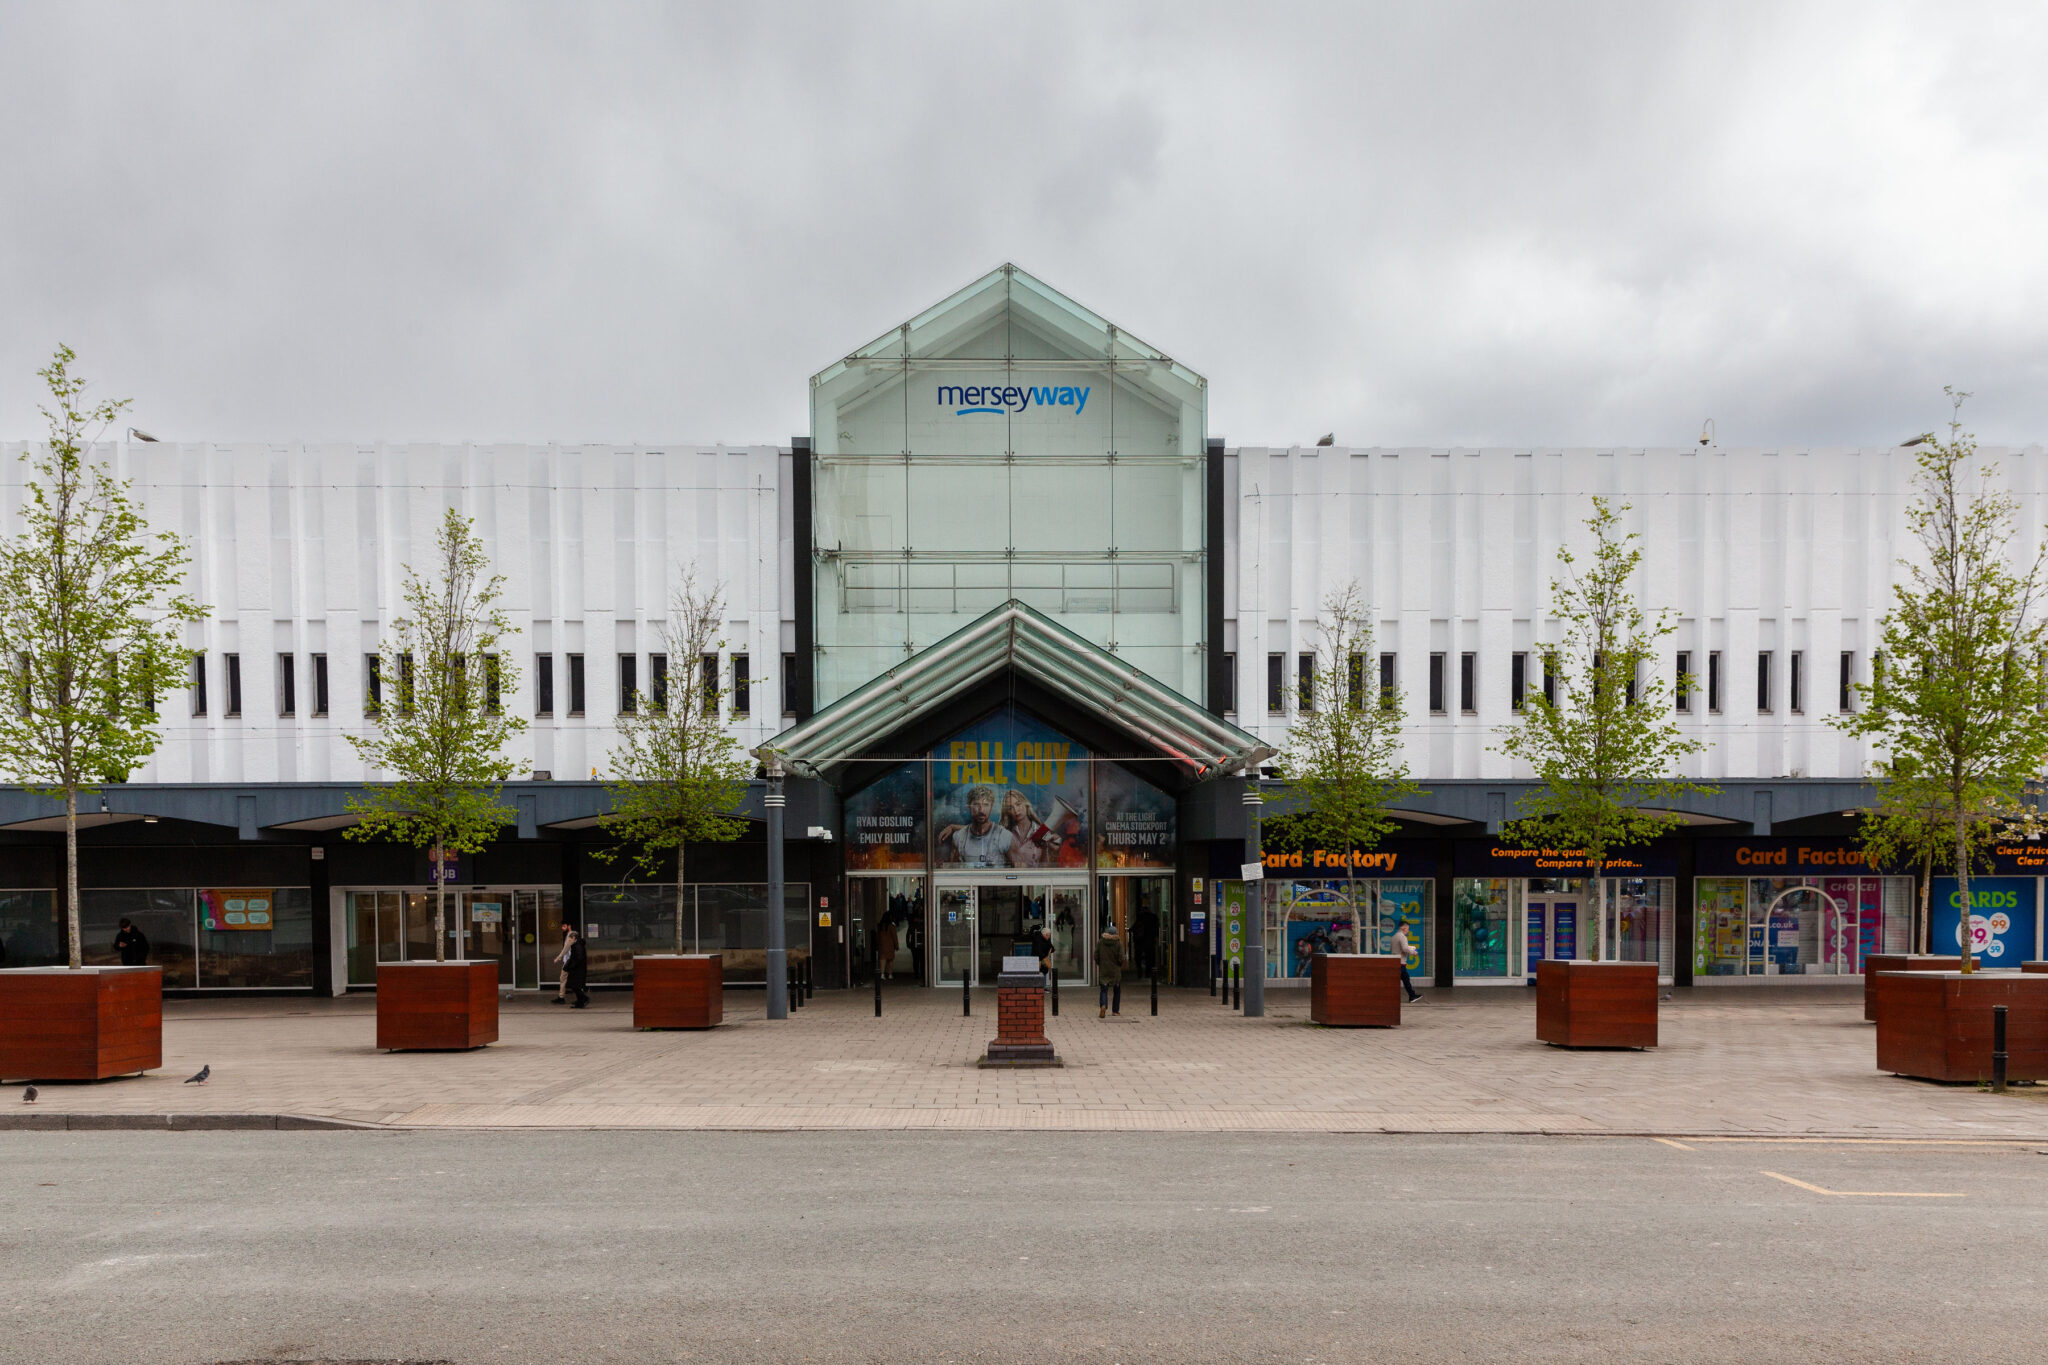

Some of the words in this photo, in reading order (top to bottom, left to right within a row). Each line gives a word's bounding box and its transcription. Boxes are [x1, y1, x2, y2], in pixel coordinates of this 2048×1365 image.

[938, 386, 1091, 415] merseyway
[950, 741, 1008, 784] FALL
[1015, 741, 1070, 785] GUY
[856, 816, 877, 827] RYAN
[879, 816, 914, 827] GOSLING
[1125, 812, 1138, 821] THE
[1138, 812, 1157, 821] LIGHT
[1105, 821, 1129, 831] CINEMA
[1130, 821, 1168, 831] STOCKPORT
[859, 832, 883, 844] EMILY
[884, 832, 910, 844] BLUNT
[1107, 833, 1136, 845] THURS
[1138, 833, 1158, 845] MAY
[1159, 833, 1166, 845] 2
[1491, 847, 1540, 859] Compare
[1541, 847, 1559, 857] the
[1736, 846, 1787, 865] Card
[1996, 845, 2024, 855] Clear
[1313, 849, 1398, 872] Factory
[1535, 858, 1583, 870] Compare
[1605, 857, 1643, 869] price...
[2016, 856, 2046, 866] Clear
[1830, 883, 1876, 892] CHOCE!
